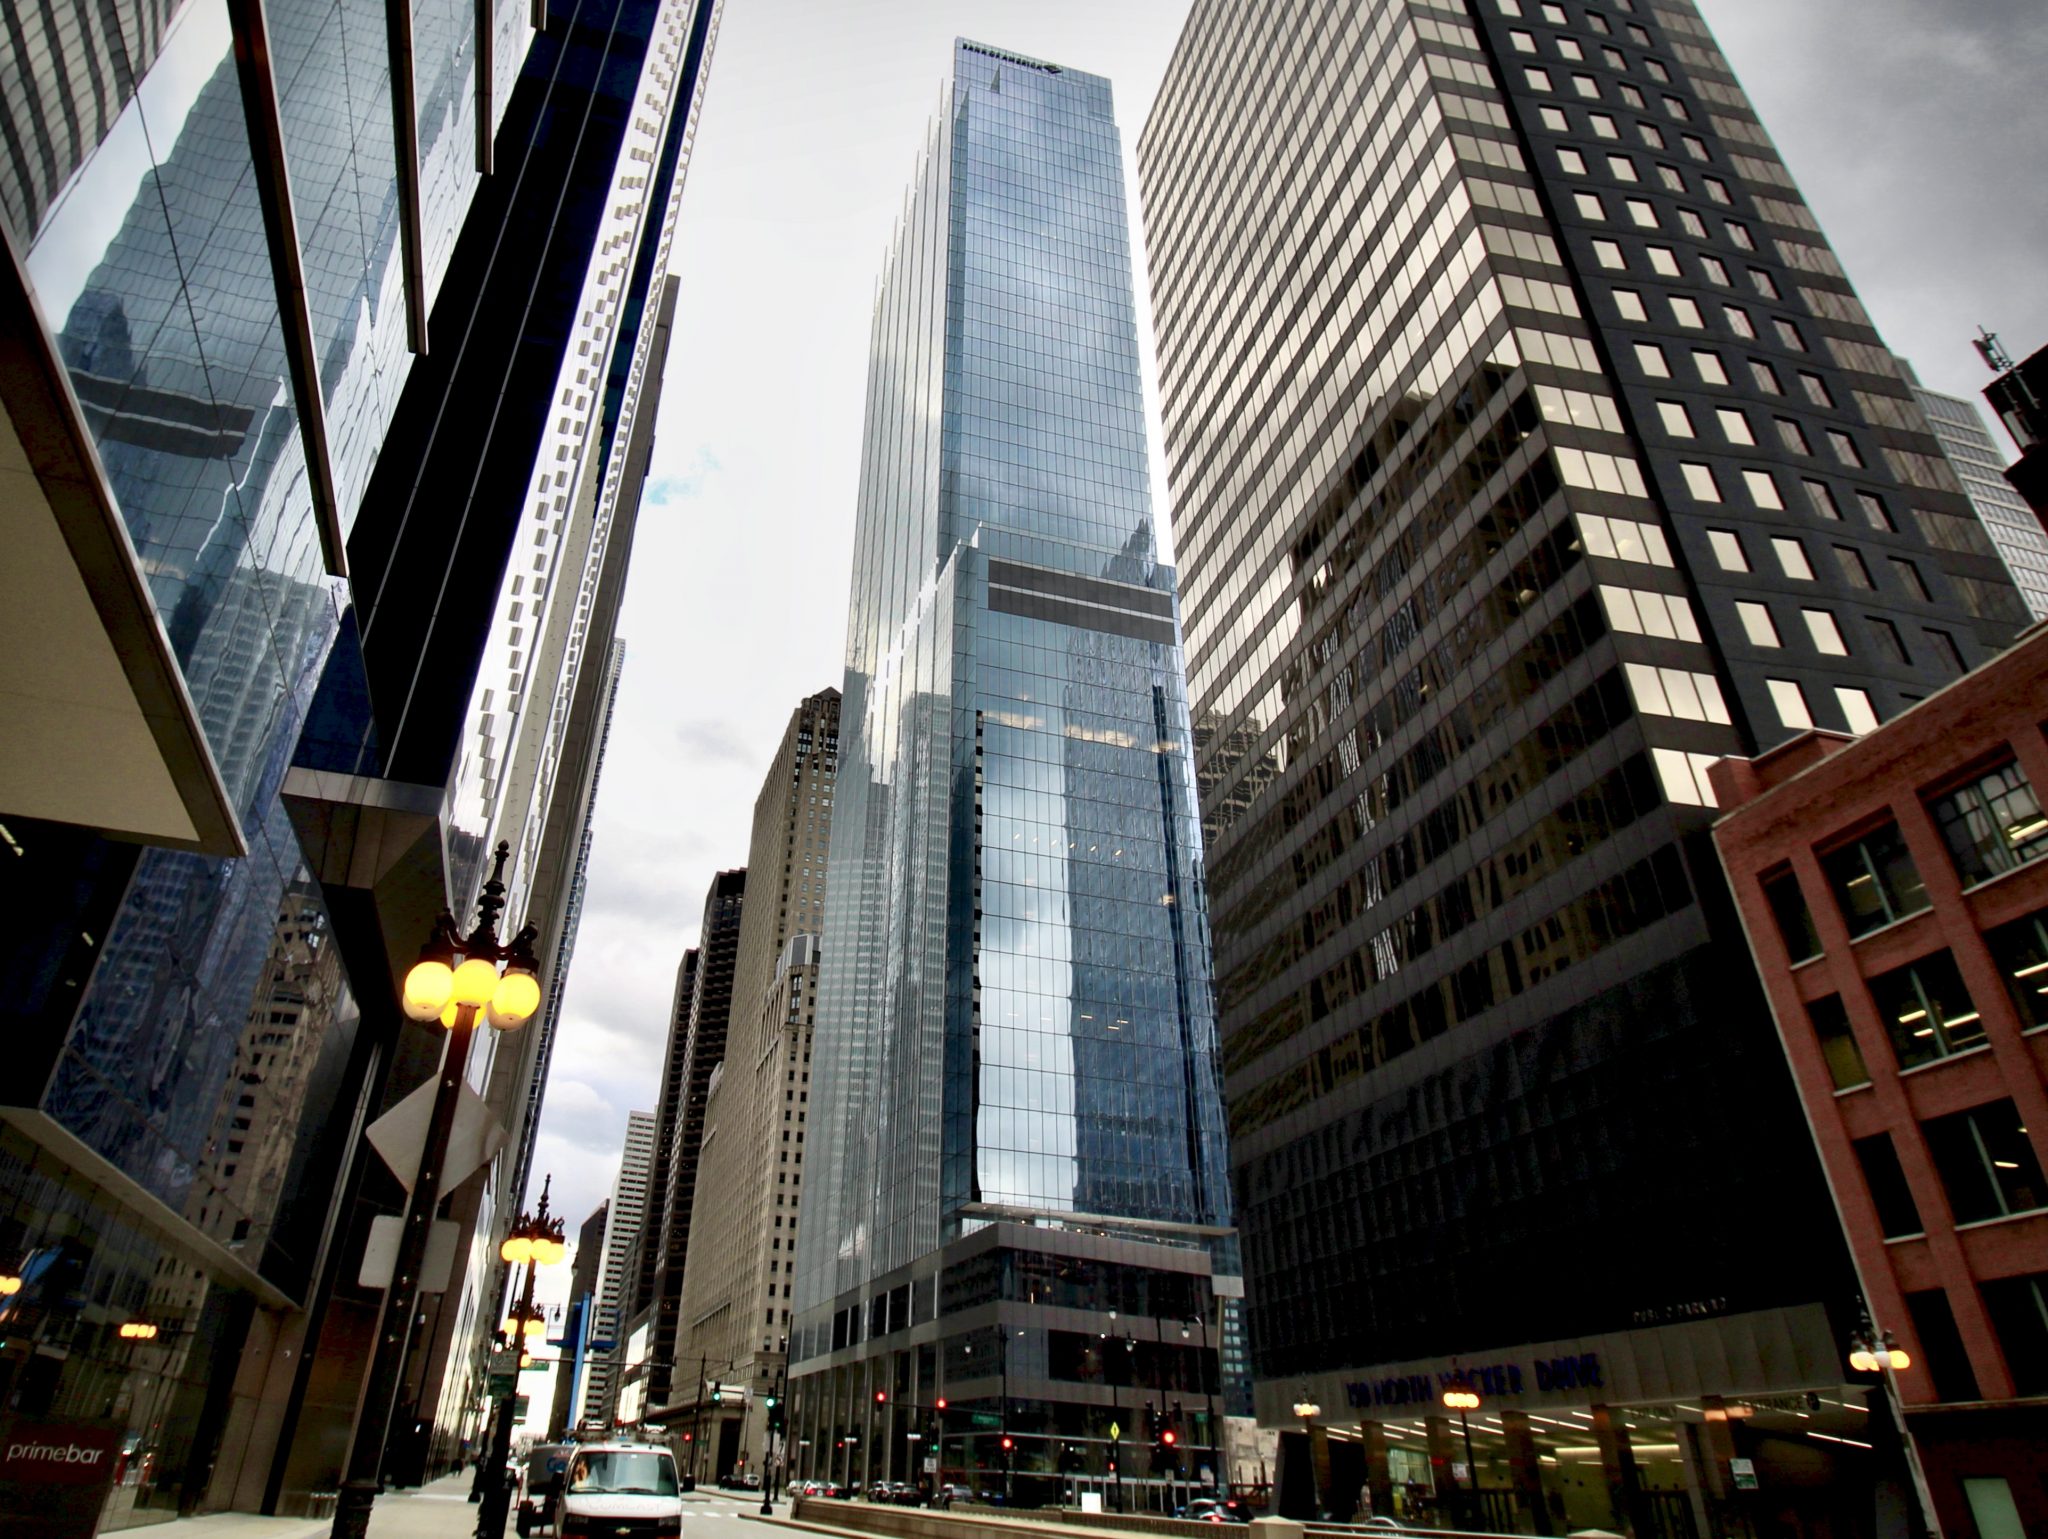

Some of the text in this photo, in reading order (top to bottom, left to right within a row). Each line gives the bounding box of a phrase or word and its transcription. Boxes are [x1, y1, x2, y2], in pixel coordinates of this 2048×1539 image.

[962, 43, 1042, 71] BANK OF AMERICA
[1633, 1296, 1726, 1323] PUBLC PARKNG
[1374, 1375, 1434, 1406] NORTH
[1534, 1353, 1604, 1391] DRIVE
[6, 1440, 104, 1464] primebar
